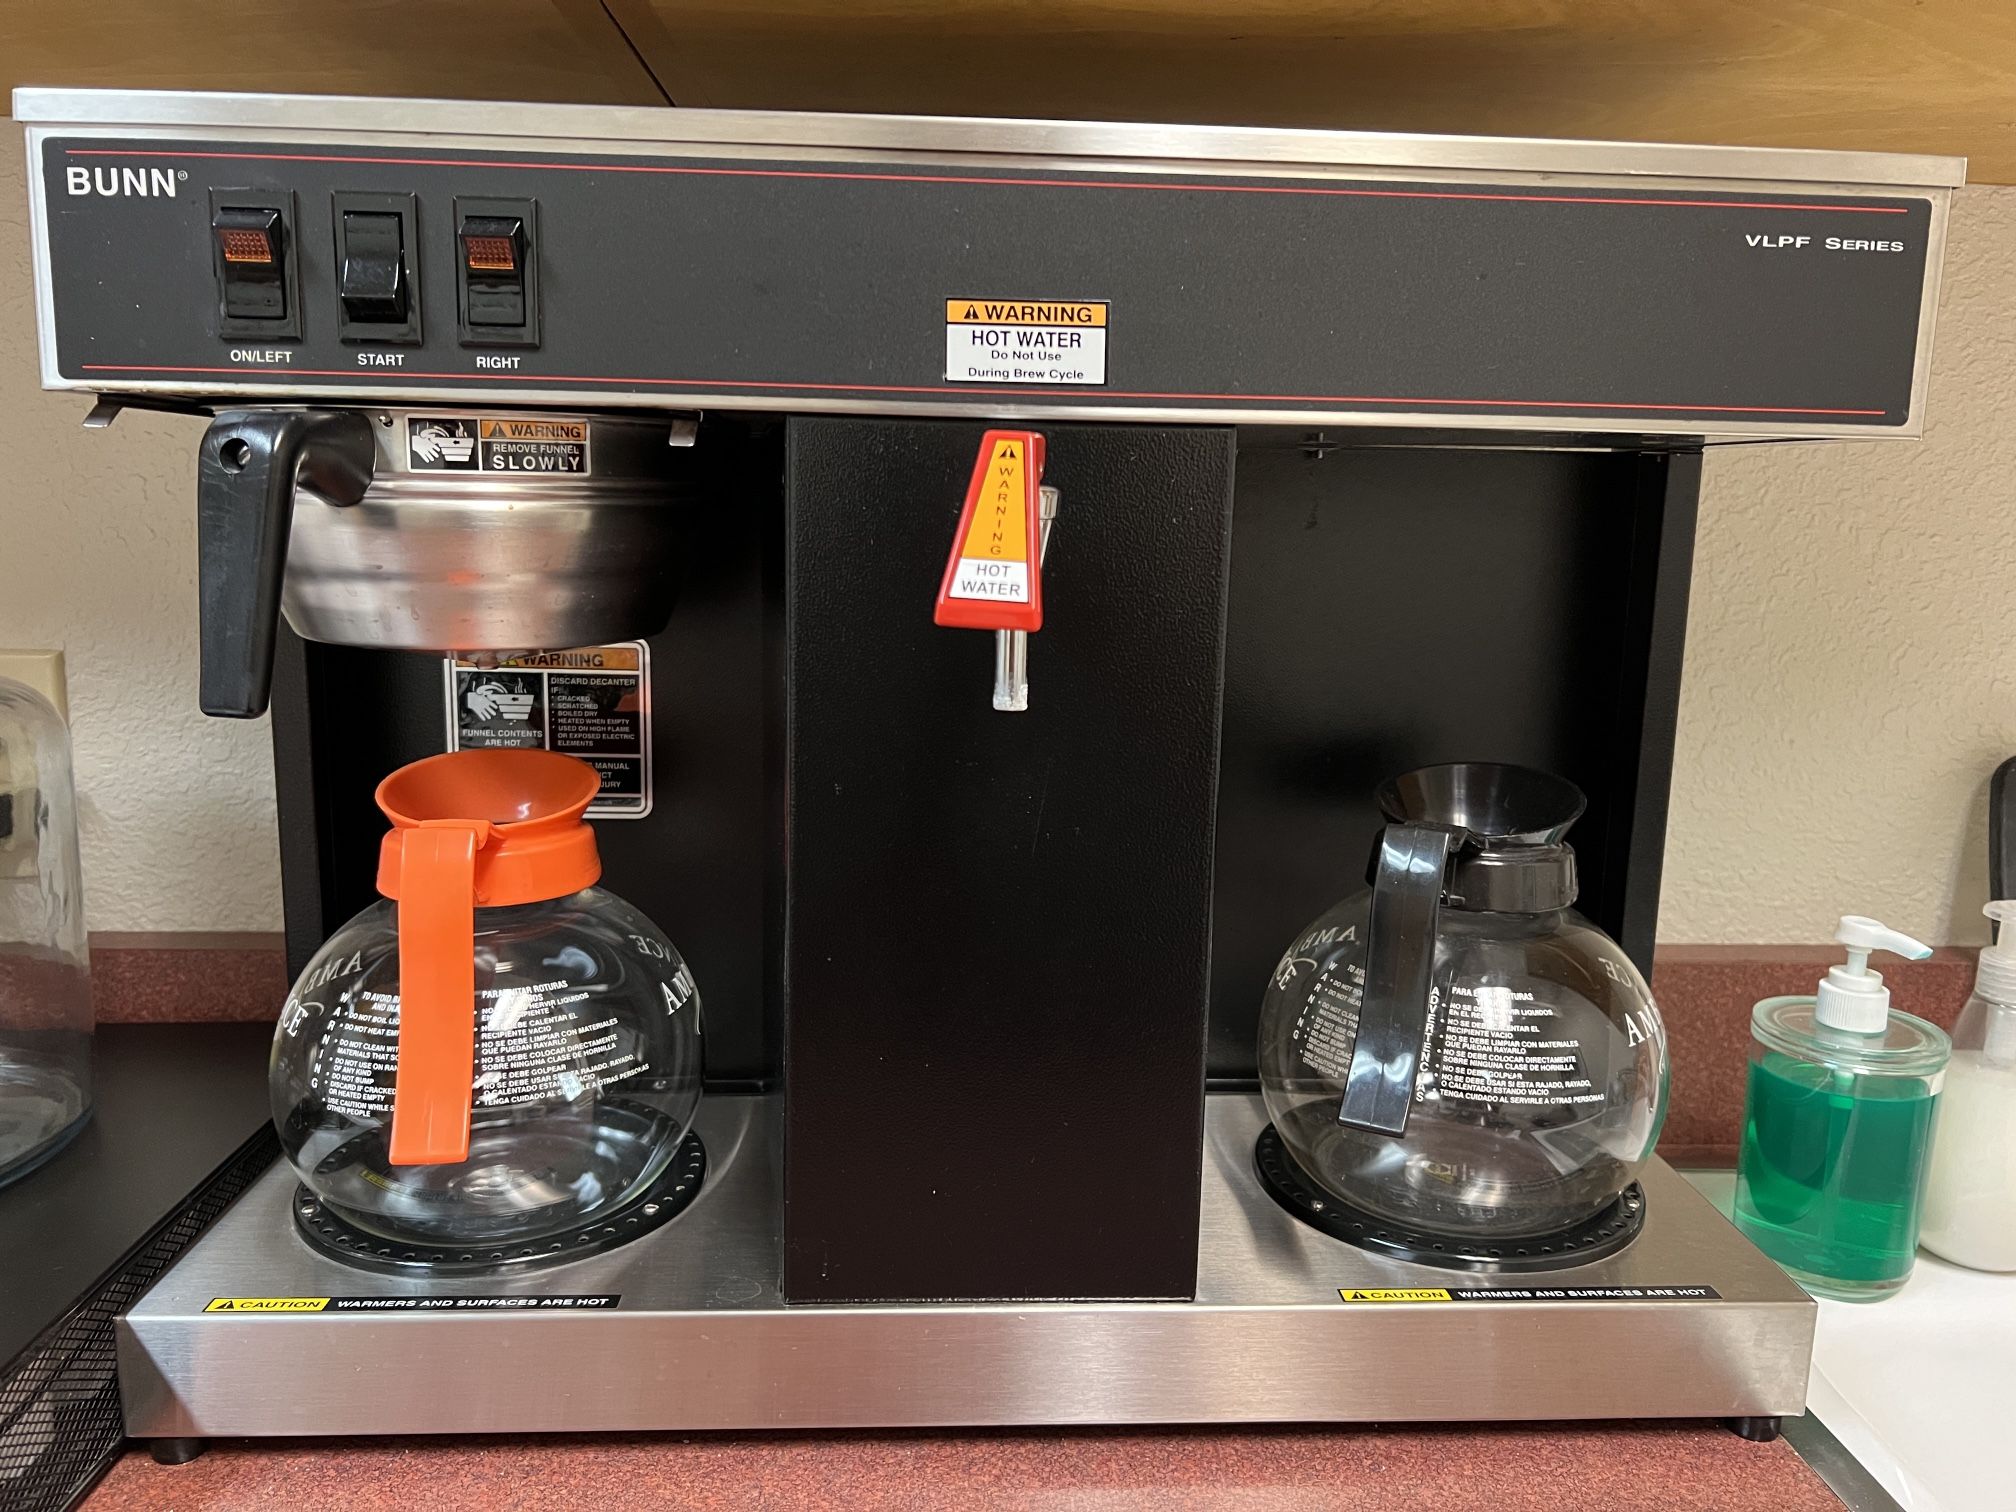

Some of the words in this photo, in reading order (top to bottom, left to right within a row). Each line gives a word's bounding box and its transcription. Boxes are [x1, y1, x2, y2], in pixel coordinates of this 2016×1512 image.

[1745, 235, 1811, 248] VLPF
[985, 305, 1092, 323] WARNING
[972, 330, 1010, 346] HOT
[1017, 332, 1082, 348] WATER
[230, 350, 292, 363] ON/LEFT
[357, 354, 404, 366] START
[992, 350, 1008, 359] Do
[1013, 351, 1034, 360] Not
[1038, 351, 1061, 361] Use
[476, 356, 520, 369] RIGHT
[969, 367, 1009, 379] During
[1015, 369, 1045, 378] Brew
[1050, 370, 1084, 380] Cycle
[510, 424, 580, 438] WARNING
[493, 444, 537, 453] REMOVE
[541, 445, 579, 454] FUNNEL
[492, 456, 579, 470] SLOWLY
[991, 467, 1013, 556] WARNING
[977, 565, 1011, 578] HOT
[962, 581, 1020, 596] WATER
[524, 654, 604, 667] WARNING
[462, 729, 496, 737] FUNNEL
[534, 980, 568, 993] ROTURAS
[558, 992, 590, 1005] LIQUIDOS
[529, 1015, 568, 1027] CALENTAR
[481, 1028, 527, 1040] RECIPIENTE
[529, 1025, 552, 1034] VACIO
[508, 1038, 527, 1046] DEBE
[529, 1032, 560, 1044] LIMPIAR
[561, 1029, 577, 1038] CON
[578, 1018, 618, 1033] MATERIALES
[1446, 1025, 1489, 1037] RECIPIENTE
[1491, 1030, 1514, 1039] VACIO
[349, 1041, 363, 1049] NOT
[363, 1043, 385, 1051] CLEAN
[501, 1044, 532, 1054] PUEDAN
[533, 1038, 567, 1049] RAYARLO
[1445, 1040, 1460, 1048] QUE
[1461, 1042, 1492, 1052] PUEDAN
[1493, 1046, 1527, 1055] RAYARLO
[1458, 1035, 1468, 1043] SE
[1470, 1036, 1490, 1045] DEBE
[1491, 1039, 1520, 1048] LIMPIAR
[1538, 1040, 1579, 1048] MATERIALES
[337, 1047, 370, 1058] MATERIALS
[495, 1055, 506, 1063] SE
[508, 1053, 527, 1062] DEBE
[529, 1047, 565, 1059] COLOCAR
[567, 1034, 618, 1051] DIRECTAMENTE
[482, 1062, 509, 1071] SOBRE
[511, 1058, 545, 1069] NINGUNA
[547, 1055, 571, 1064] CLASE
[583, 1043, 617, 1057] HORNILLA
[1443, 1048, 1454, 1056] NO
[1456, 1050, 1466, 1058] SE
[1467, 1051, 1487, 1060] DEBE
[1489, 1054, 1524, 1063] COLOCAR
[1526, 1055, 1577, 1063] DIRECTAMENTE
[345, 1059, 358, 1067] NOT
[359, 1061, 372, 1069] USE
[1442, 1055, 1468, 1065] SOBRE
[1469, 1059, 1504, 1069] NINGUNA
[1505, 1062, 1528, 1071] CLASE
[342, 1066, 355, 1074] ANY
[330, 1081, 356, 1091] DISCARD
[342, 1074, 354, 1082] NOT
[355, 1077, 374, 1085] BUMP
[484, 1096, 510, 1106] TENGA
[512, 1092, 545, 1104] CUIDADO
[597, 1075, 619, 1085] OTRAS
[619, 1063, 650, 1080] PERSONAS
[1454, 1075, 1464, 1083] SE
[1465, 1076, 1485, 1085] DEBE
[1487, 1078, 1506, 1087] USAR
[338, 1090, 361, 1099] HEATED
[1448, 1081, 1491, 1093] CALENTADO
[1493, 1087, 1526, 1096] ESTANDO
[1527, 1088, 1549, 1096] VACIO
[1440, 1088, 1464, 1099] TENGA
[1465, 1091, 1499, 1102] CUIDADO
[1510, 1097, 1543, 1105] SERVIRLE
[1550, 1096, 1572, 1104] OTRAS
[1573, 1094, 1605, 1103] PERSONAS
[327, 1104, 346, 1113] OTHER
[346, 1108, 370, 1117] PEOPLE
[328, 1097, 339, 1105] USE
[340, 1100, 366, 1109] CAUTION
[368, 1103, 388, 1111] WHILE
[1370, 1291, 1444, 1300] CAUTION
[1457, 1291, 1531, 1299] WARMERS
[1535, 1290, 1564, 1299] AND
[1568, 1290, 1643, 1298] SURFACES
[1646, 1289, 1675, 1297] ARE
[1677, 1288, 1706, 1297] HOT
[240, 1301, 321, 1309] CAUTION
[337, 1300, 416, 1308] WARMERS
[420, 1300, 451, 1308] AND
[456, 1299, 537, 1307] SURFACES
[576, 1298, 609, 1306] HOT
